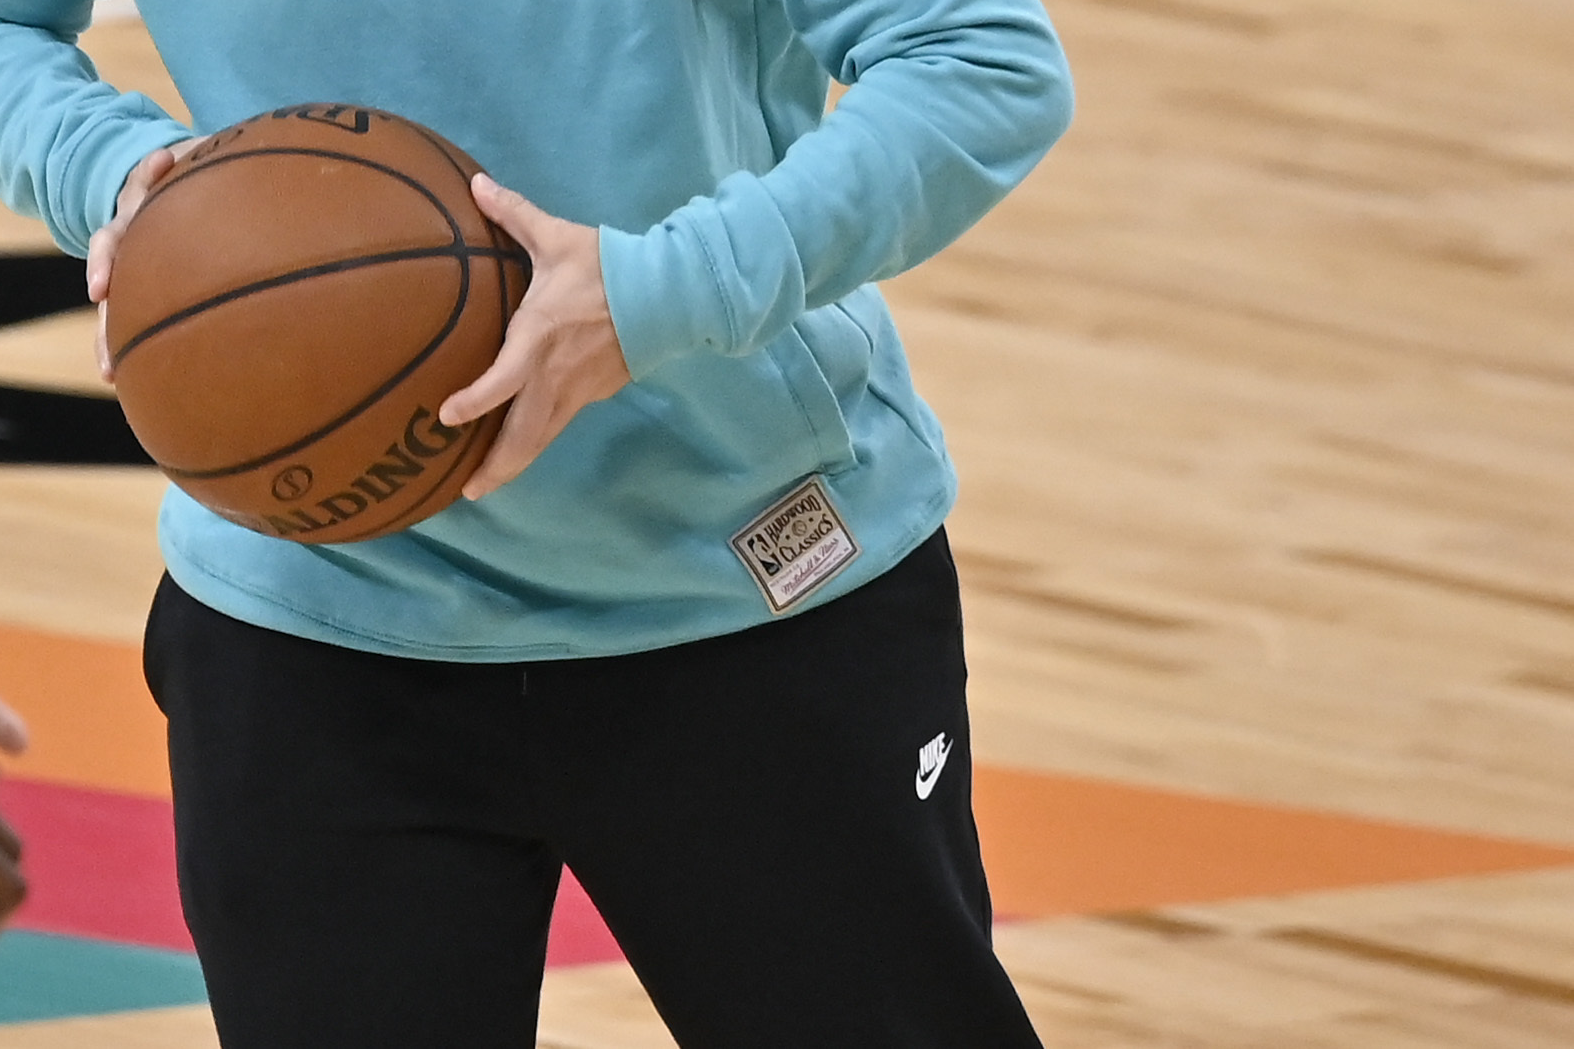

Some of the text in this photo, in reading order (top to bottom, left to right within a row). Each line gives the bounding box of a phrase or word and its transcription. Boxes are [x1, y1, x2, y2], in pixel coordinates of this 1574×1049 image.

[763, 494, 822, 548] HARDWOOD
[778, 513, 834, 563] CLASSICS
[919, 731, 946, 777] NIKE
